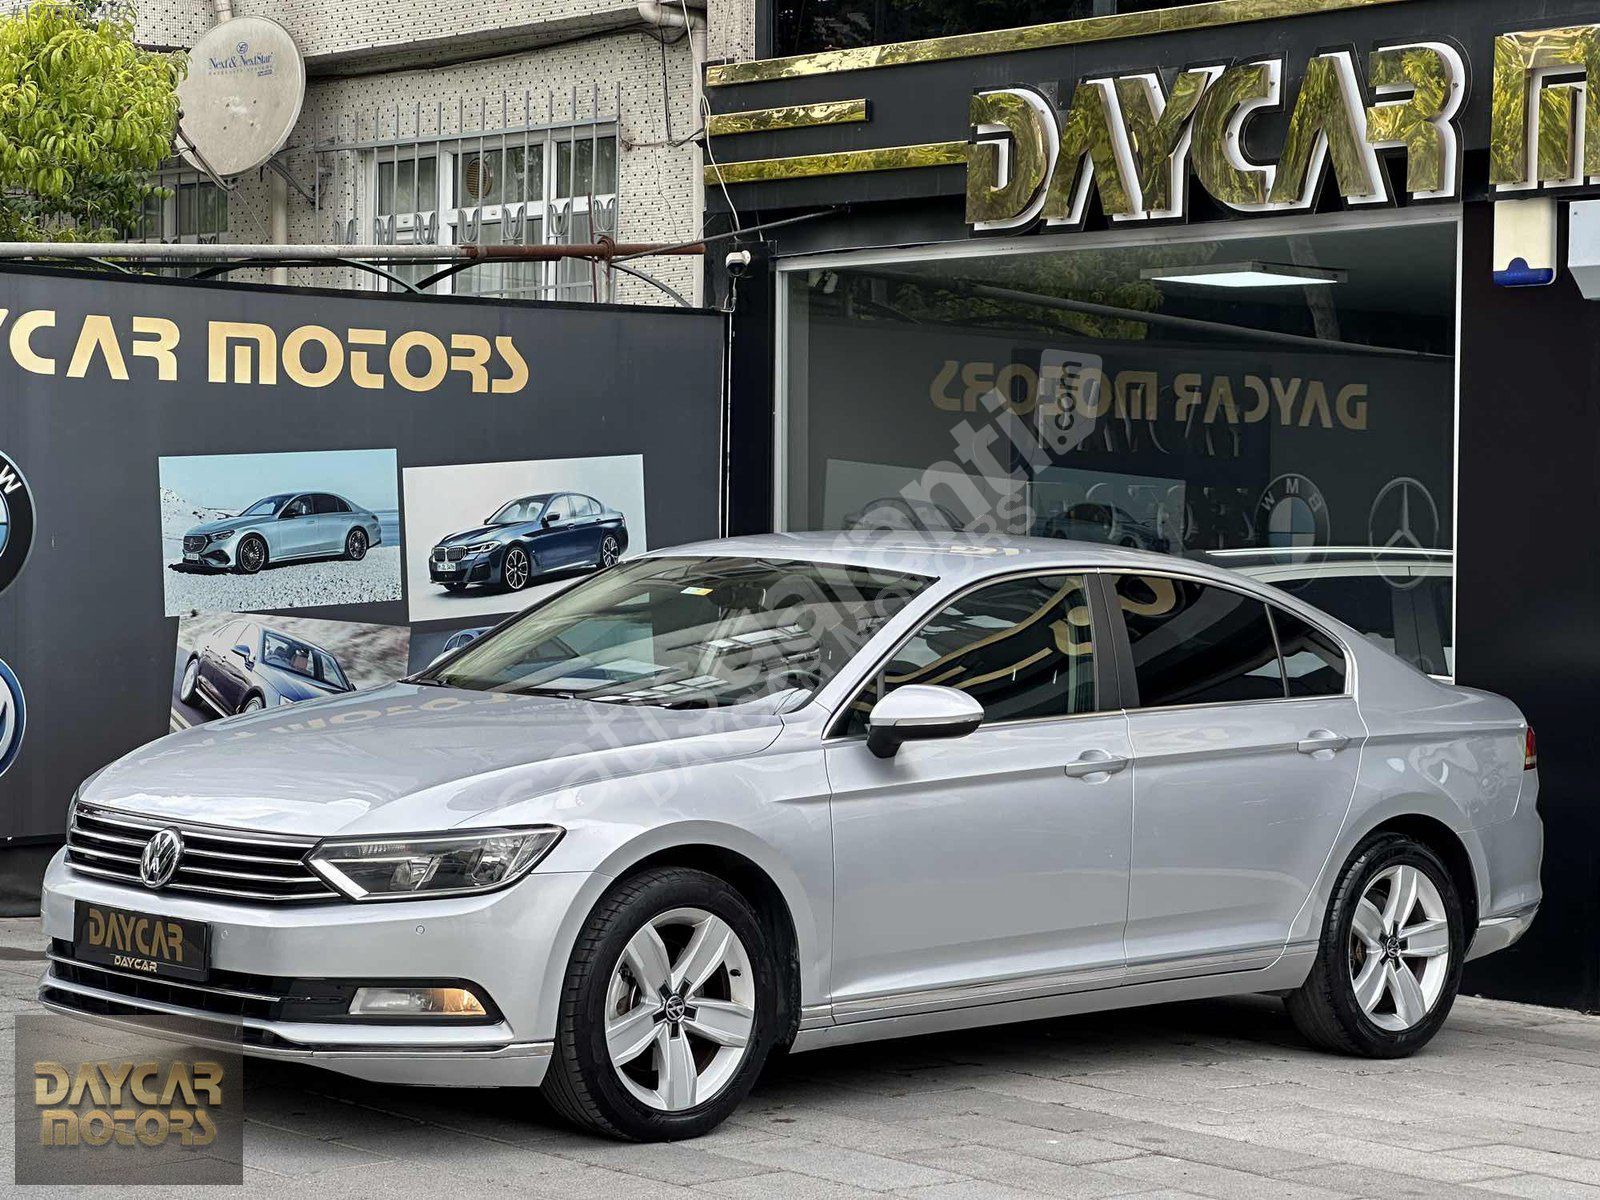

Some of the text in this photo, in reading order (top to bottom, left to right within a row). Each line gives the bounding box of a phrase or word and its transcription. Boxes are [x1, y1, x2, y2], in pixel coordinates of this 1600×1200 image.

[965, 41, 1466, 229] DAYCAR
[208, 320, 529, 394] MOTORS
[88, 907, 184, 962] DAYCAR
[114, 955, 158, 973] DAYCAR
